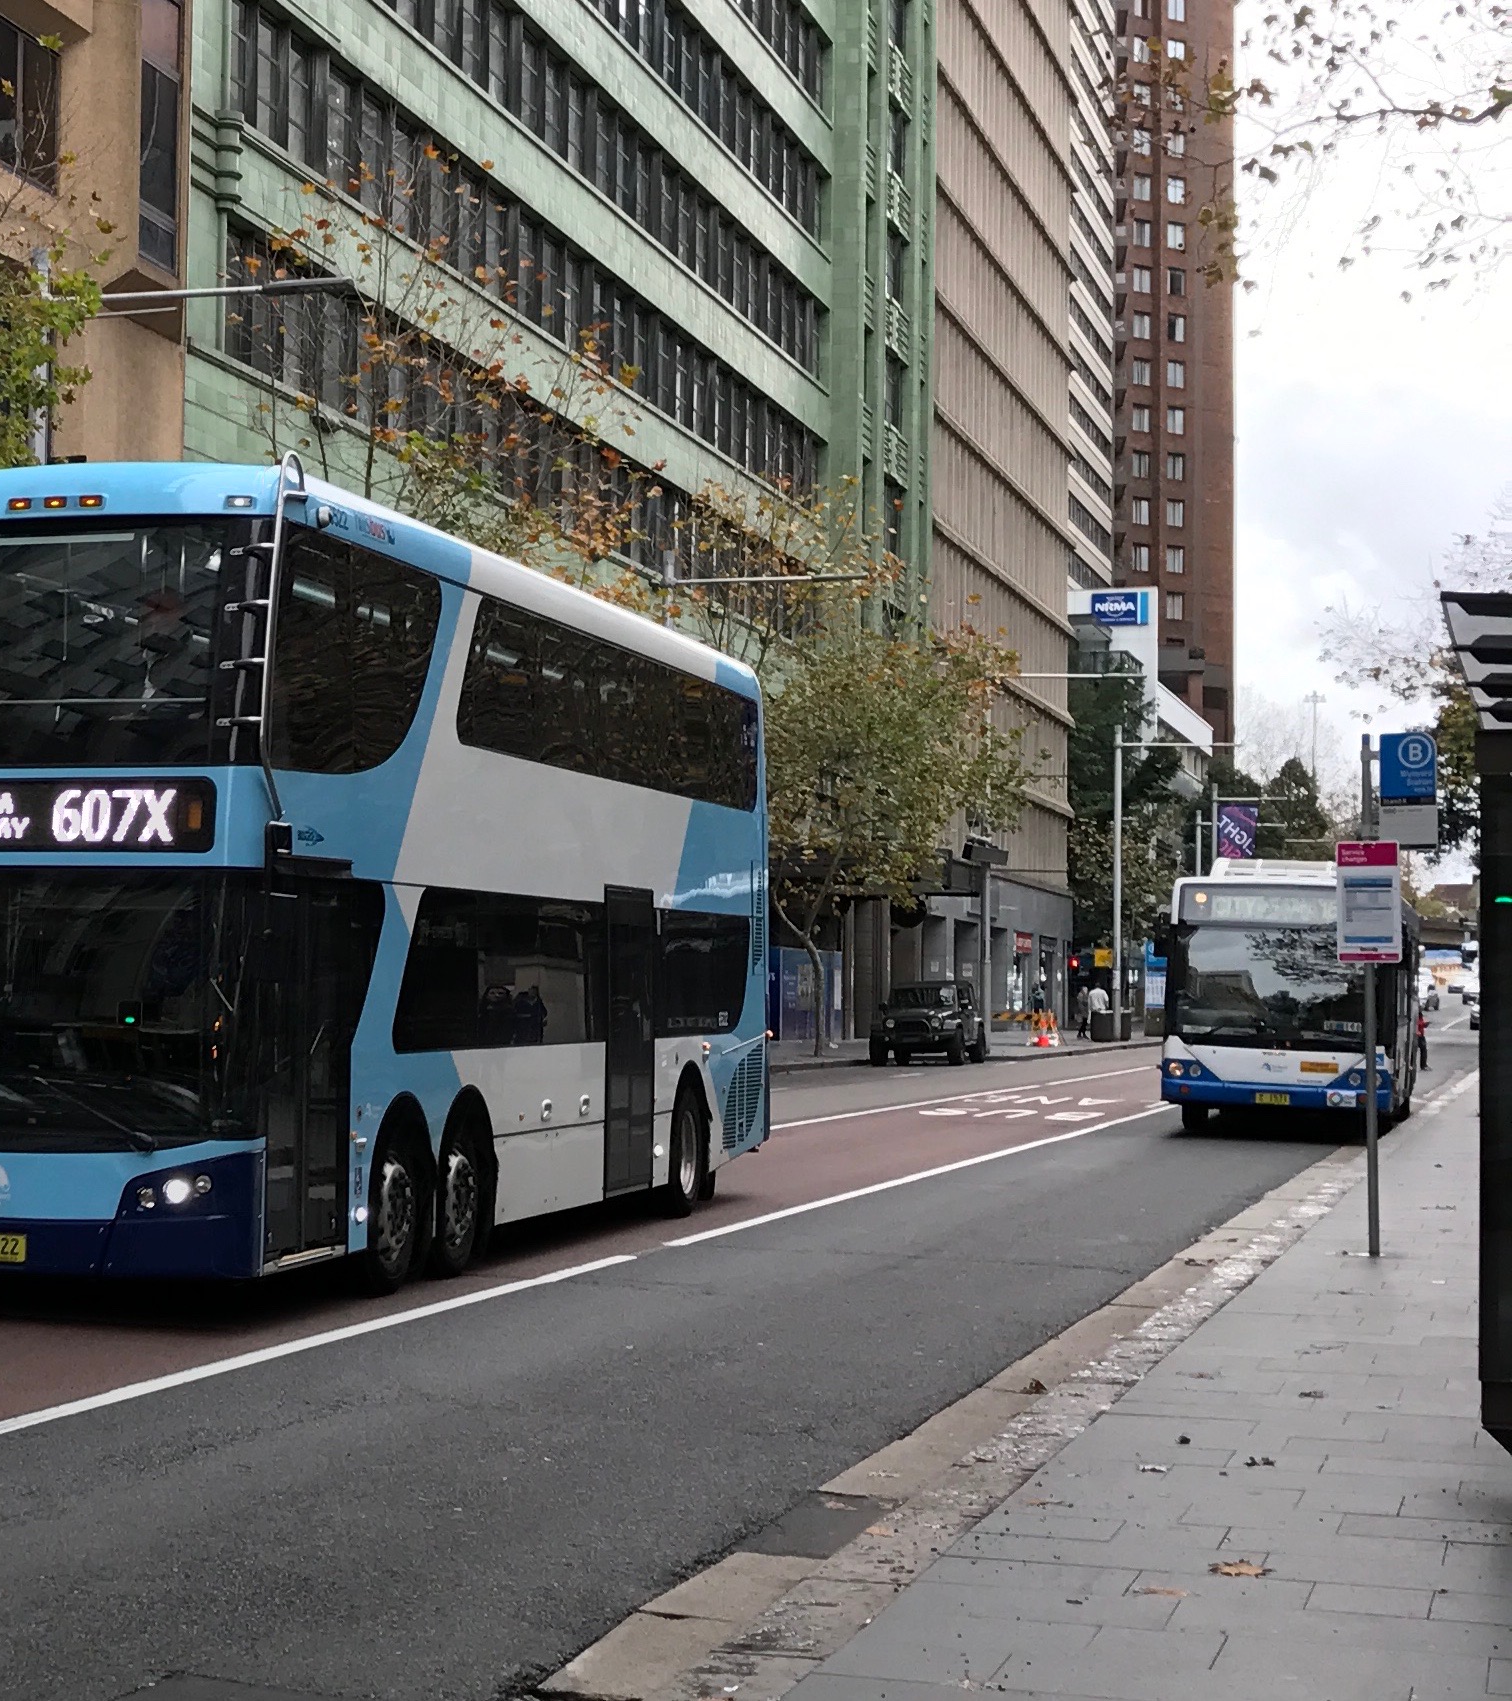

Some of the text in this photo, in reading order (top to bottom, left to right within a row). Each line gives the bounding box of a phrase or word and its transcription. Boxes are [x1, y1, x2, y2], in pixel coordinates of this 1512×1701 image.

[1095, 601, 1136, 612] NRMA
[1408, 743, 1422, 761] B
[52, 789, 177, 842] 607X
[919, 1107, 1105, 1121] BUS
